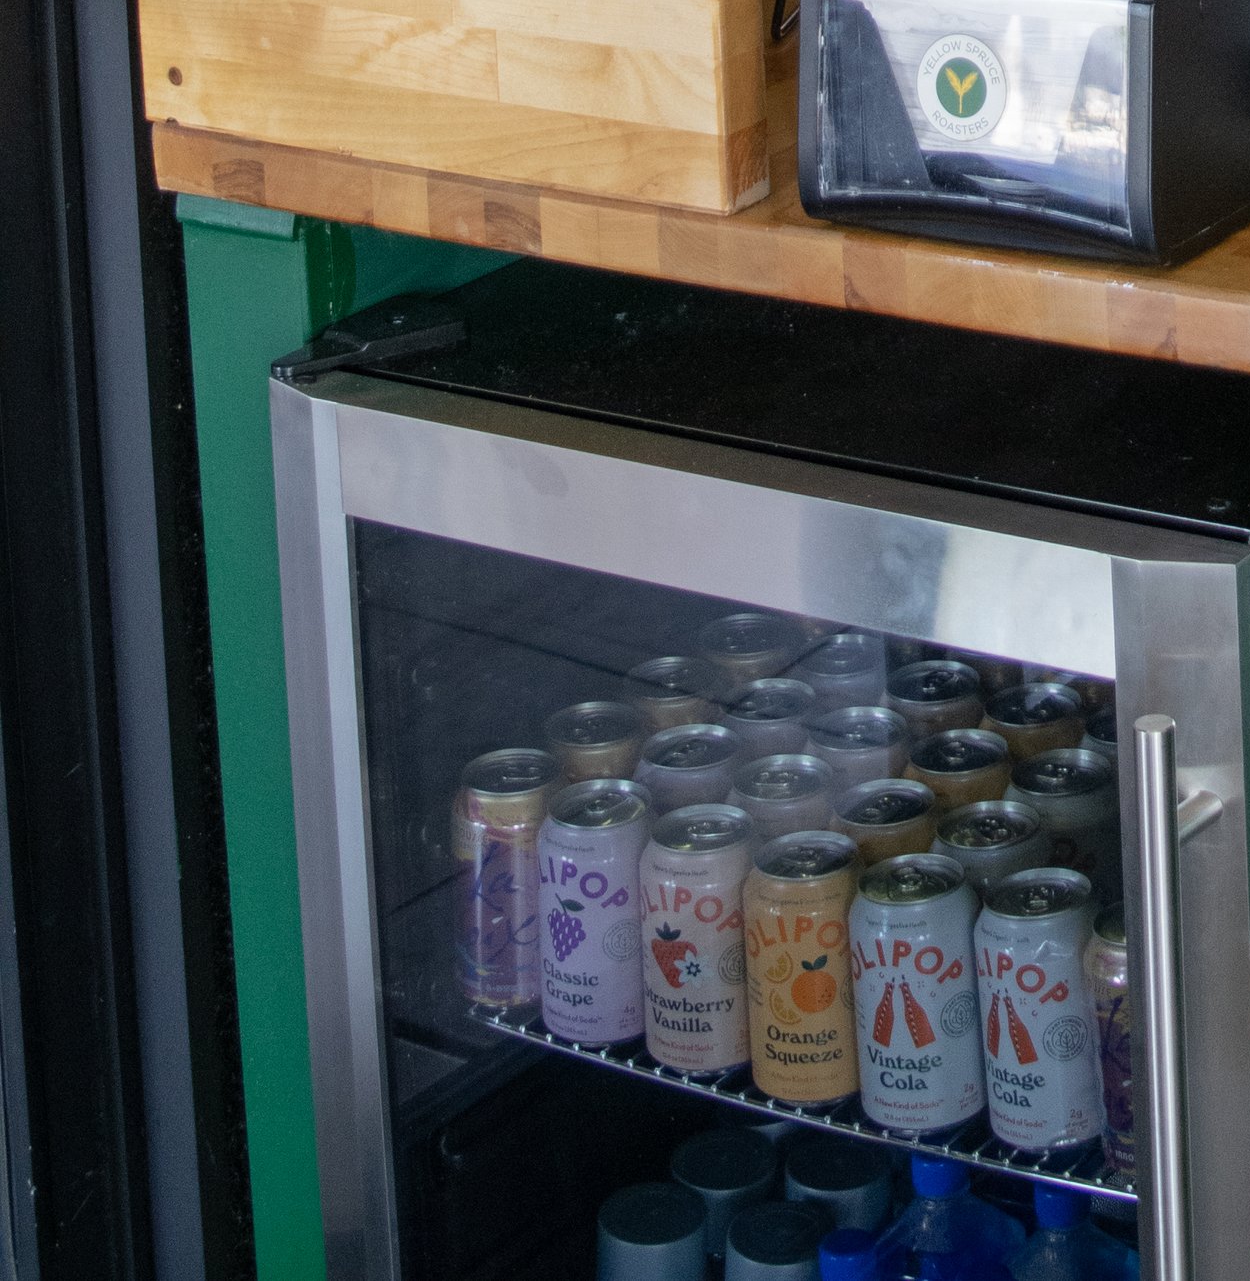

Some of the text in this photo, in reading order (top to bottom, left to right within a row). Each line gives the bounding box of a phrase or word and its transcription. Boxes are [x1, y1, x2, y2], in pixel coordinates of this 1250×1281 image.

[923, 40, 1000, 86] YELLOW SPRUCE
[932, 109, 989, 136] ROASTERS
[652, 1006, 714, 1034] Vanilla
[767, 1024, 838, 1046] Orange
[765, 1043, 844, 1066] Squeeze
[867, 1044, 943, 1073] Vintage
[879, 1071, 928, 1091] Cola
